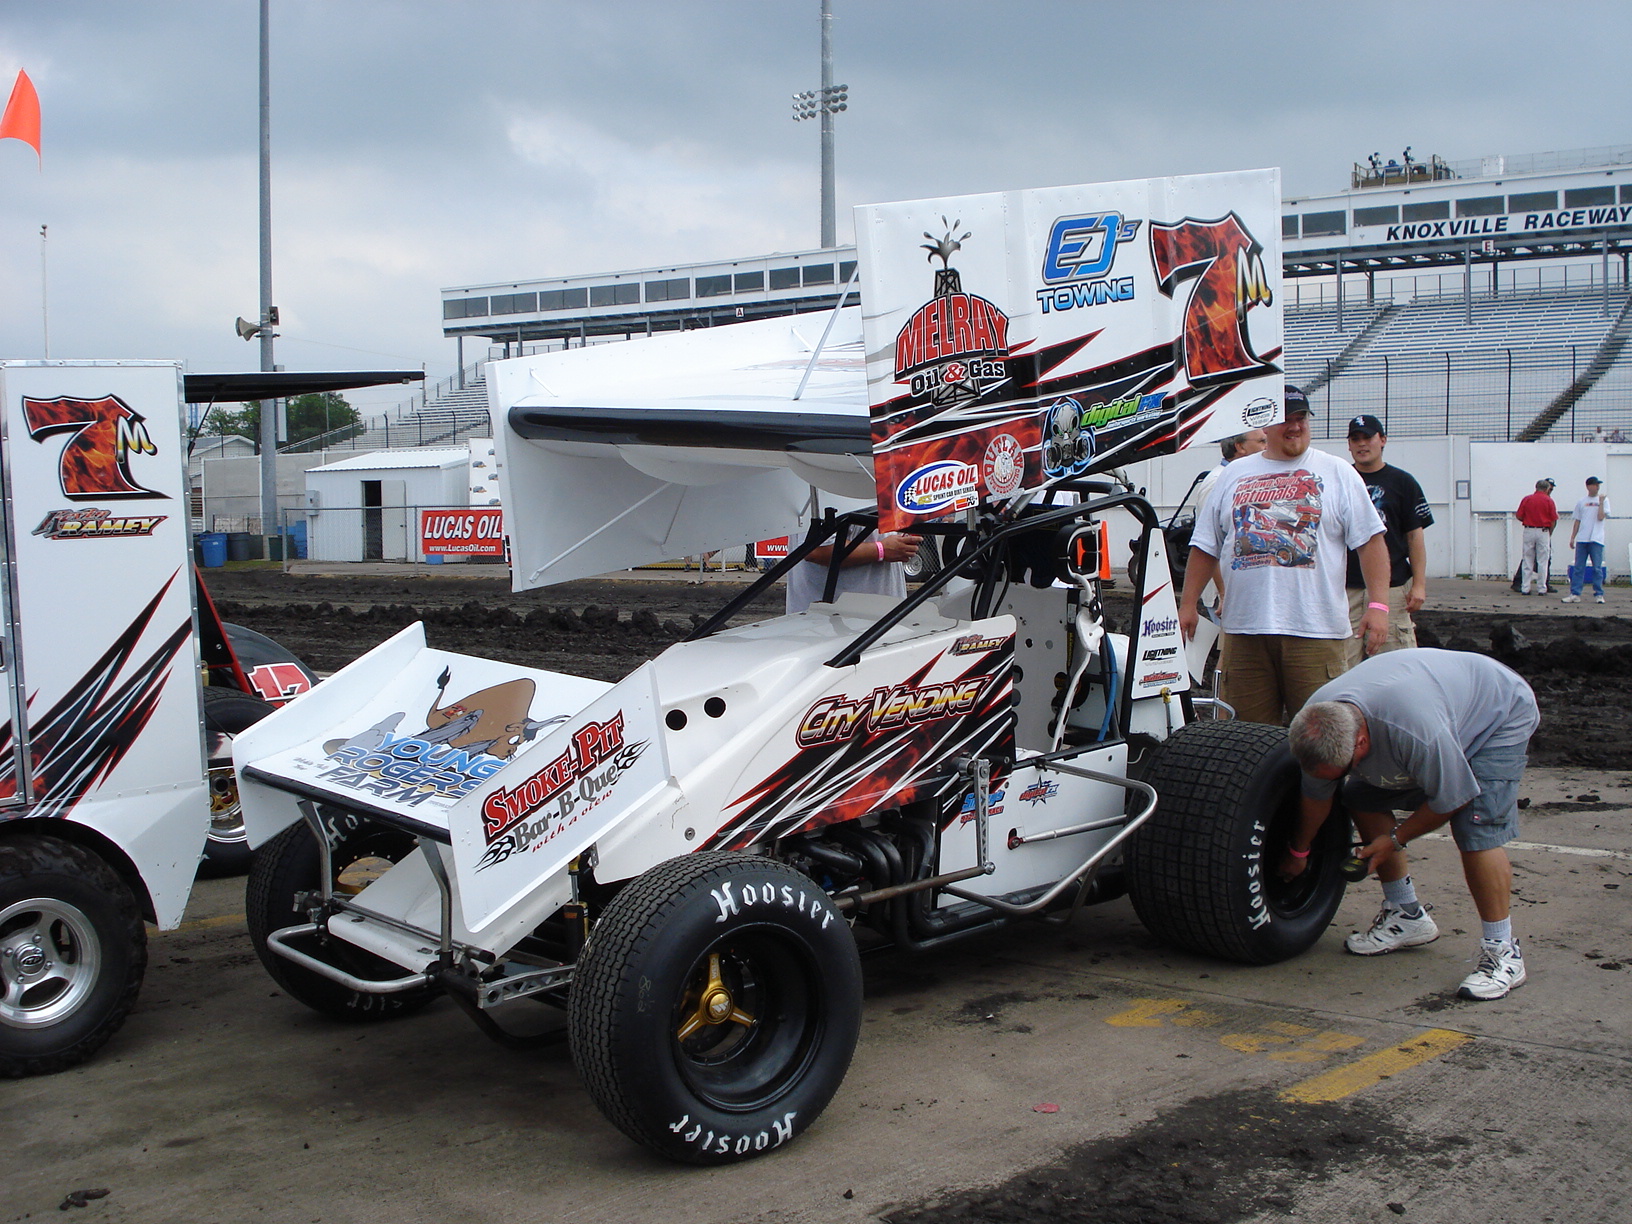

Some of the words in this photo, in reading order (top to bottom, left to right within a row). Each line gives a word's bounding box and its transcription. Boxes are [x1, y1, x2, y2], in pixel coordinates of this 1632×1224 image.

[1386, 217, 1509, 241] KNOXVILLE
[1524, 206, 1632, 230] RACEWAY
[1485, 241, 1491, 251] E
[1036, 276, 1135, 314] TOWING
[895, 292, 1009, 382] MELRAY
[910, 368, 941, 397] Oil
[944, 362, 967, 384] &
[968, 359, 1005, 379] Gas
[915, 471, 955, 496] LUCAS
[957, 466, 977, 484] OIL
[1233, 486, 1298, 506] Nationals
[56, 517, 162, 538] RAMEY
[424, 515, 474, 539] LUCAS
[477, 515, 501, 539] OIL
[429, 544, 496, 552] www.LucasOil.com
[1141, 616, 1178, 637] Hoosier
[797, 695, 872, 747] CITY
[866, 676, 988, 733] VENDING
[373, 731, 508, 779] YOUNG
[315, 765, 437, 808] FARM
[513, 766, 619, 850] Bar-B-Que
[532, 823, 565, 853] with
[568, 815, 578, 826] a
[1242, 820, 1271, 930] Hoosier
[711, 880, 835, 929] Hoosier
[669, 1111, 797, 1155] Hoosier
